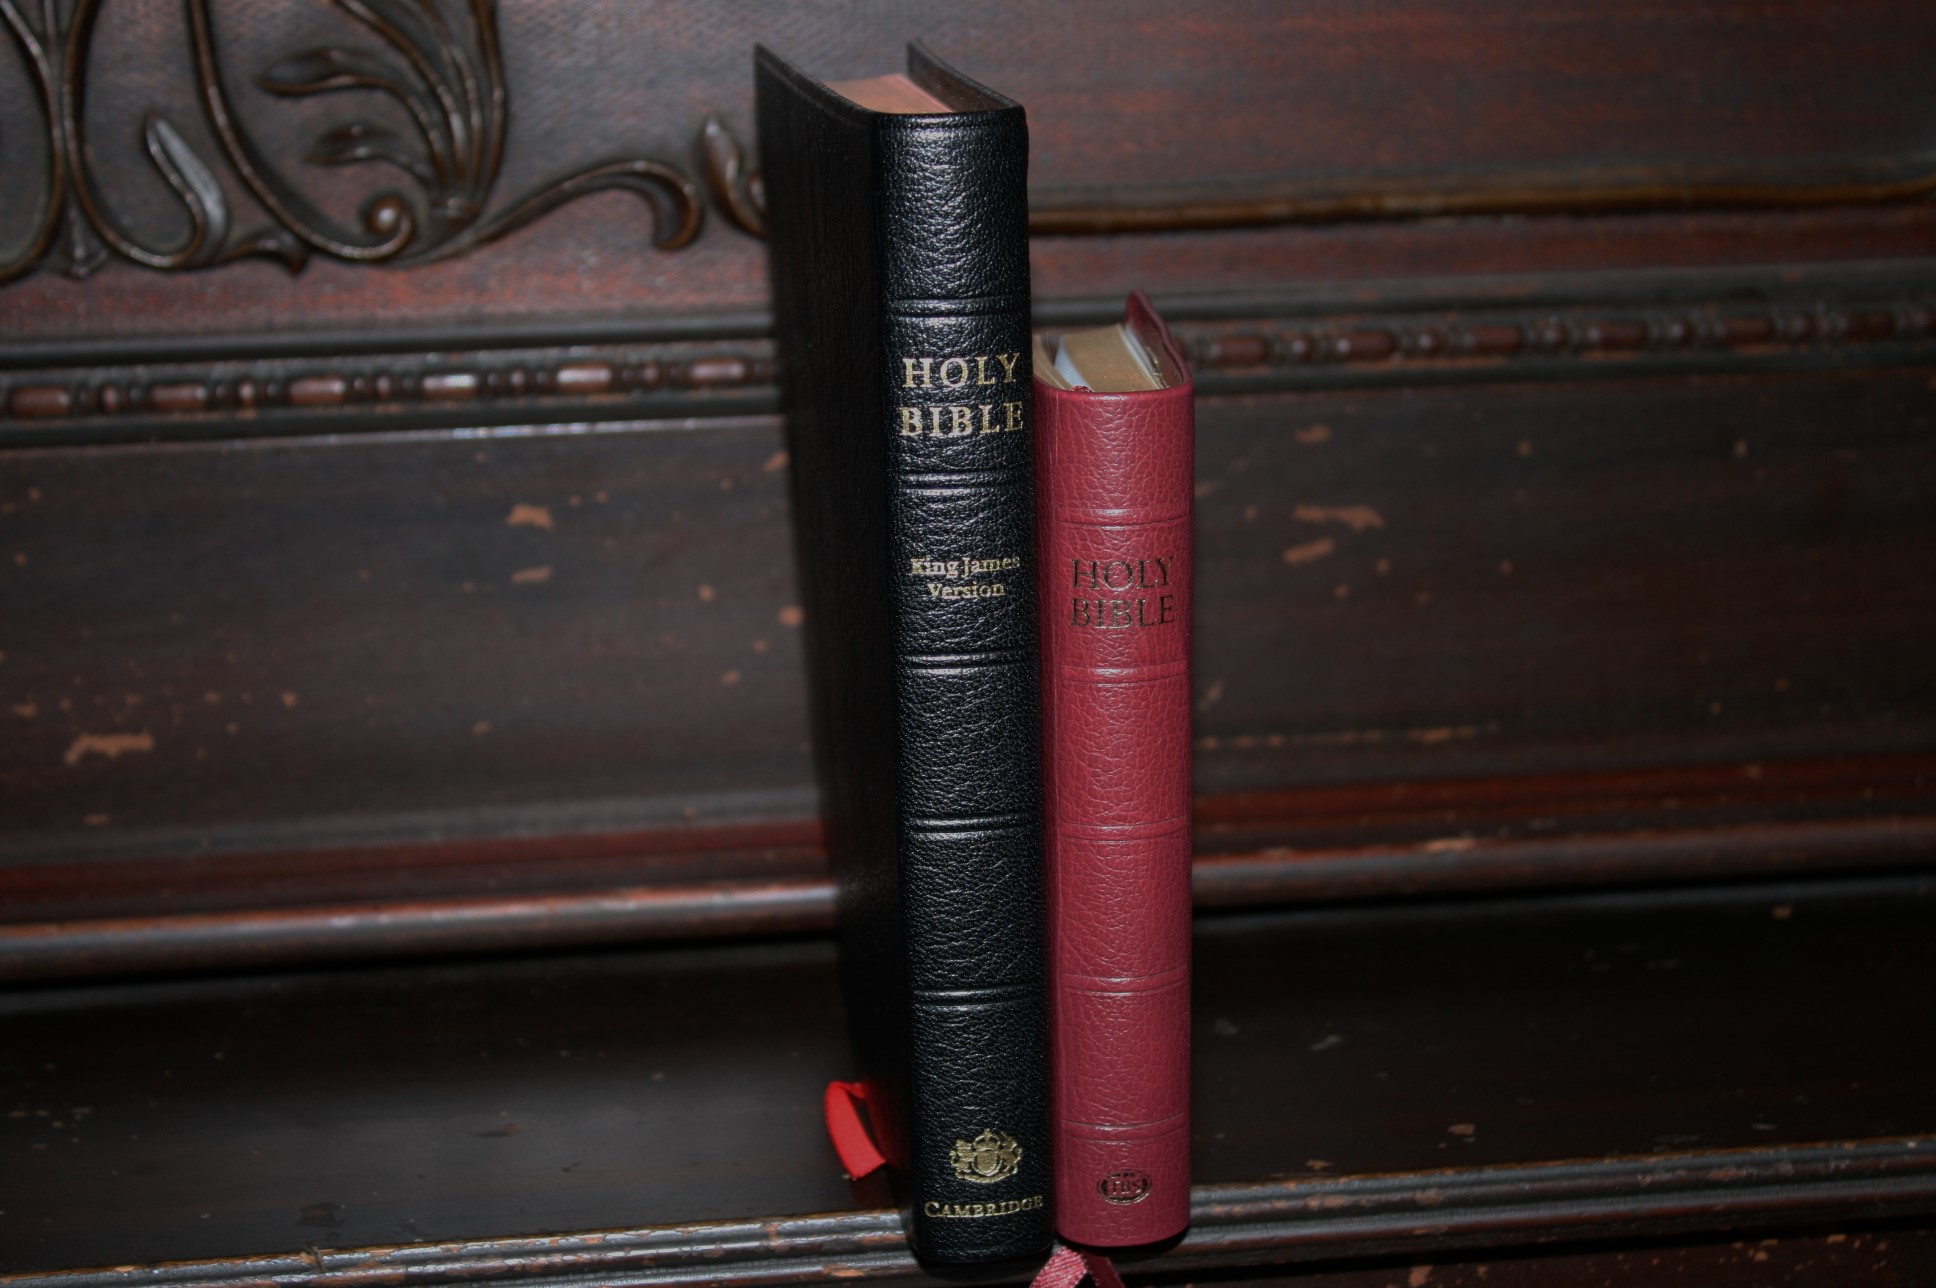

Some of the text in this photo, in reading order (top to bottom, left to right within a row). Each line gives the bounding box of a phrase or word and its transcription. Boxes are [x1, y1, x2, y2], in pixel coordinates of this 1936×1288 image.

[902, 352, 1020, 388] HOLY
[899, 400, 1024, 438] BIBLE
[911, 556, 1020, 578] King James
[1072, 555, 1175, 591] HOLY
[927, 581, 1006, 600] Version
[1071, 594, 1174, 629] BIBLE
